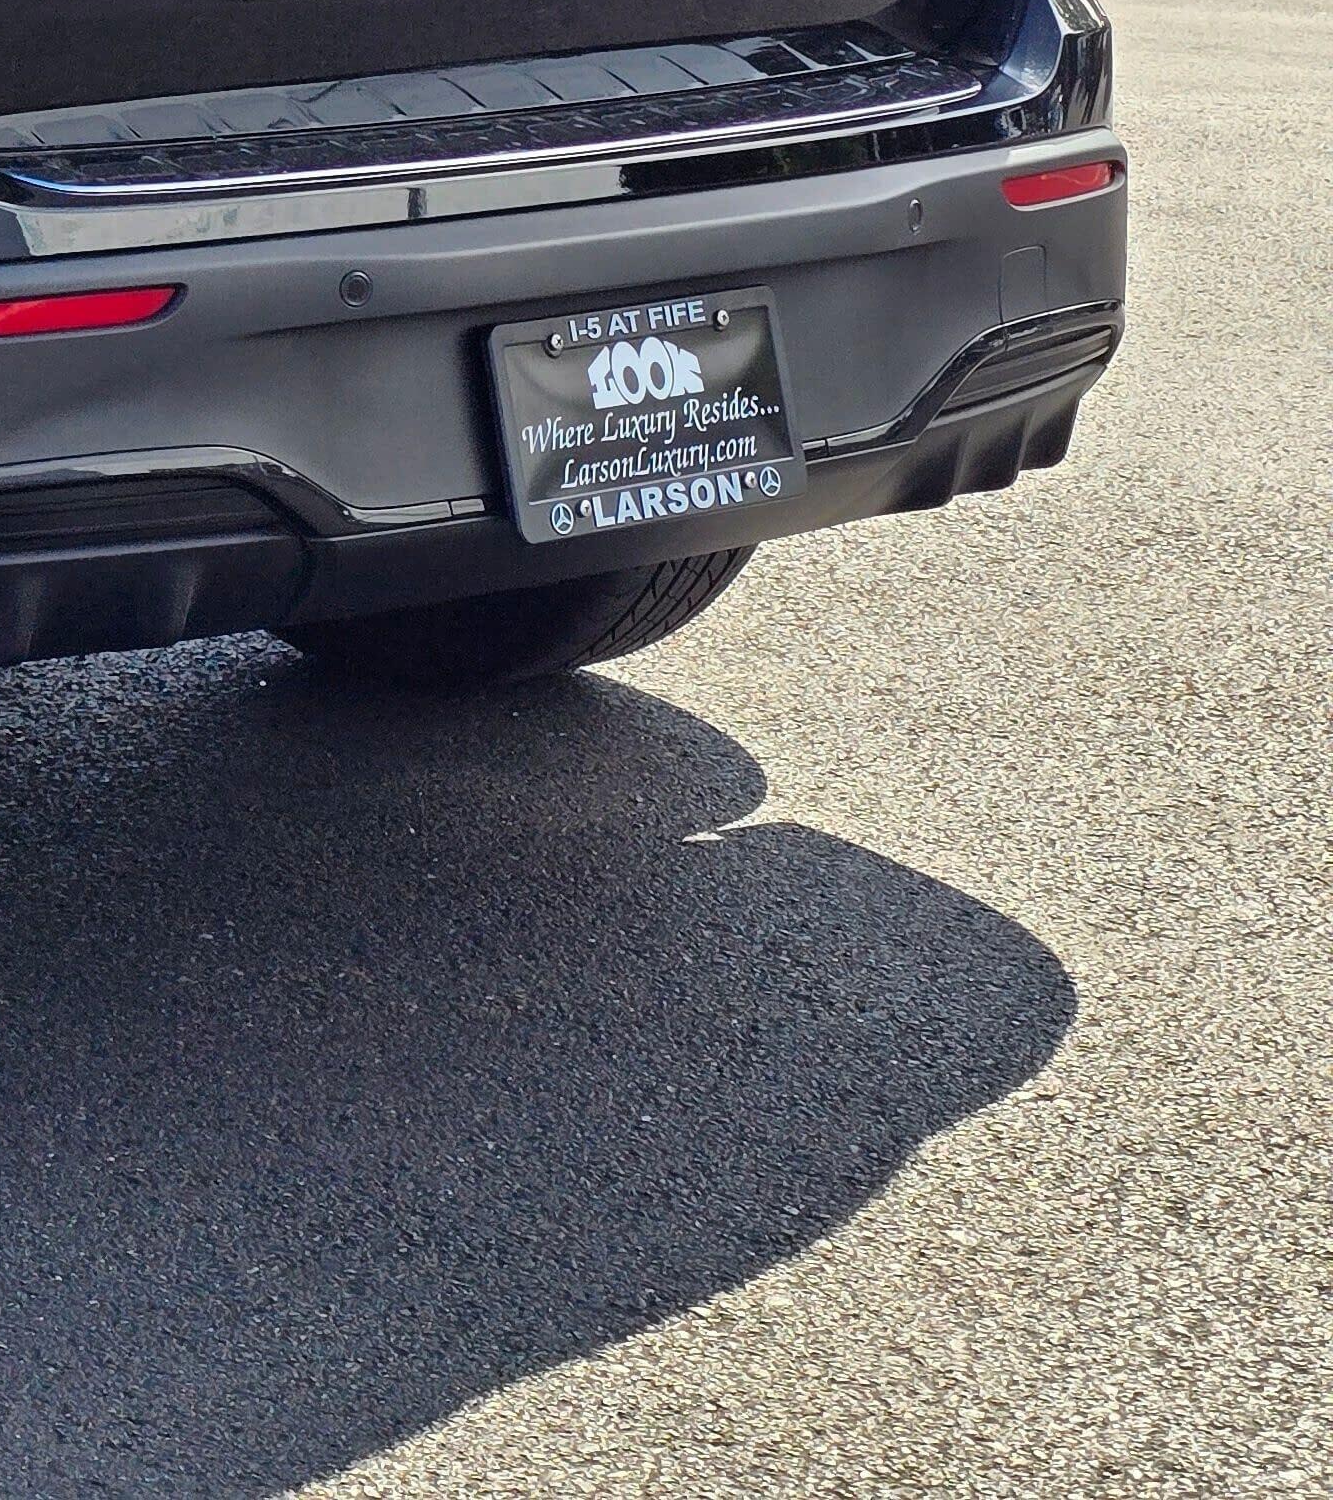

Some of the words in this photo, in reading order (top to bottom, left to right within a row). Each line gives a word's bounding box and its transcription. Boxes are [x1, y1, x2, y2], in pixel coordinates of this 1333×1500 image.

[569, 317, 602, 342] I-5
[608, 310, 640, 337] AT
[648, 300, 706, 329] FIFE
[587, 337, 705, 409] LOOK
[521, 416, 595, 454] Where
[600, 409, 677, 444] Luxury
[683, 387, 780, 432] Resides...
[560, 435, 757, 489] LarsonLuxury.com
[591, 471, 744, 528] LARSON
